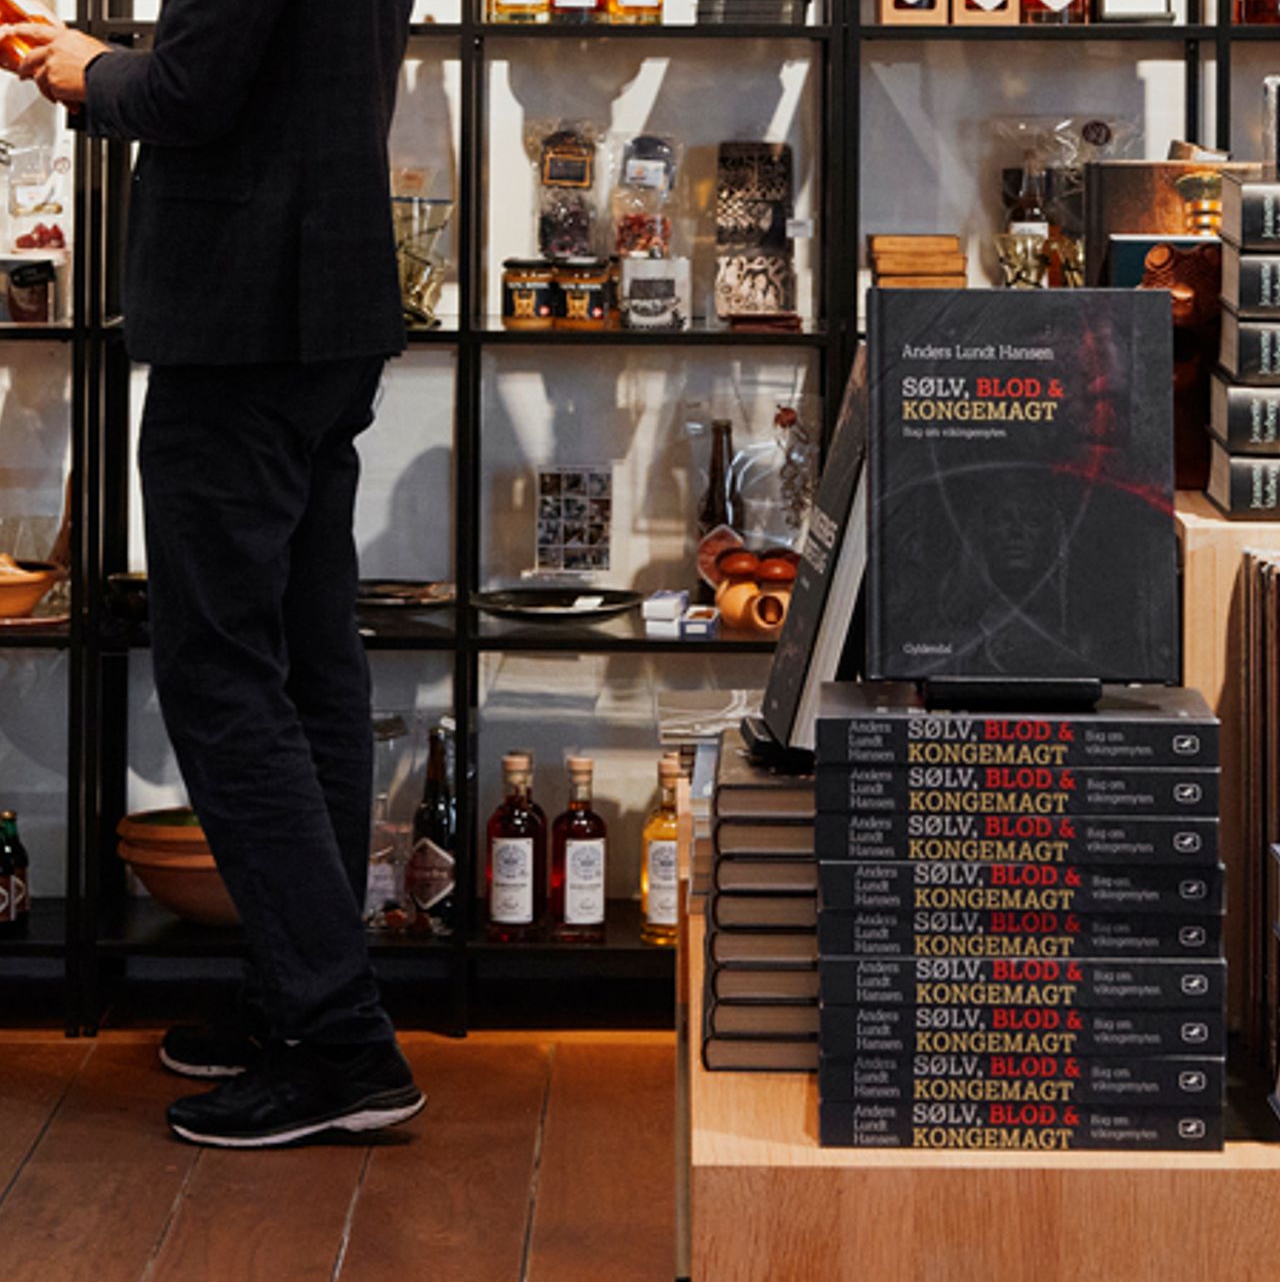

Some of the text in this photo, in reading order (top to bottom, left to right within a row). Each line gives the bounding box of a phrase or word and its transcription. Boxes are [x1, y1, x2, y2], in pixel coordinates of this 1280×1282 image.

[902, 344, 1054, 360] Anders Lundt Hansen
[902, 377, 1064, 399] SØLV, BLOD &
[902, 401, 1058, 421] KONGEMAGT
[907, 720, 1075, 741] SØLV, BLOD &
[907, 743, 1068, 764] KONGEMAGT
[908, 768, 1076, 789] SØLV, BLOD &
[908, 791, 1069, 812] KONGEMAGT
[908, 817, 1076, 838] SØLV, BLOD &
[908, 840, 1069, 861] KONGEMAGT
[914, 865, 1082, 886] SØLV, BLOD &
[914, 888, 1075, 909] KONGEMAGT
[913, 912, 1081, 933] SØLV, BLOD &
[913, 935, 1074, 956] KONGEMAGT
[915, 960, 1083, 981] SØLV, BLOD &
[915, 983, 1076, 1004] KONGEMAGT
[915, 1009, 1083, 1030] SØLV, BLOD &
[915, 1032, 1076, 1053] KONGEMAGT
[913, 1056, 1081, 1077] SØLV, BLOD &
[913, 1079, 1074, 1100] KONGEMAGT
[912, 1104, 1080, 1125] SØLV, BLOD &
[912, 1127, 1073, 1148] KONGEMAGT
